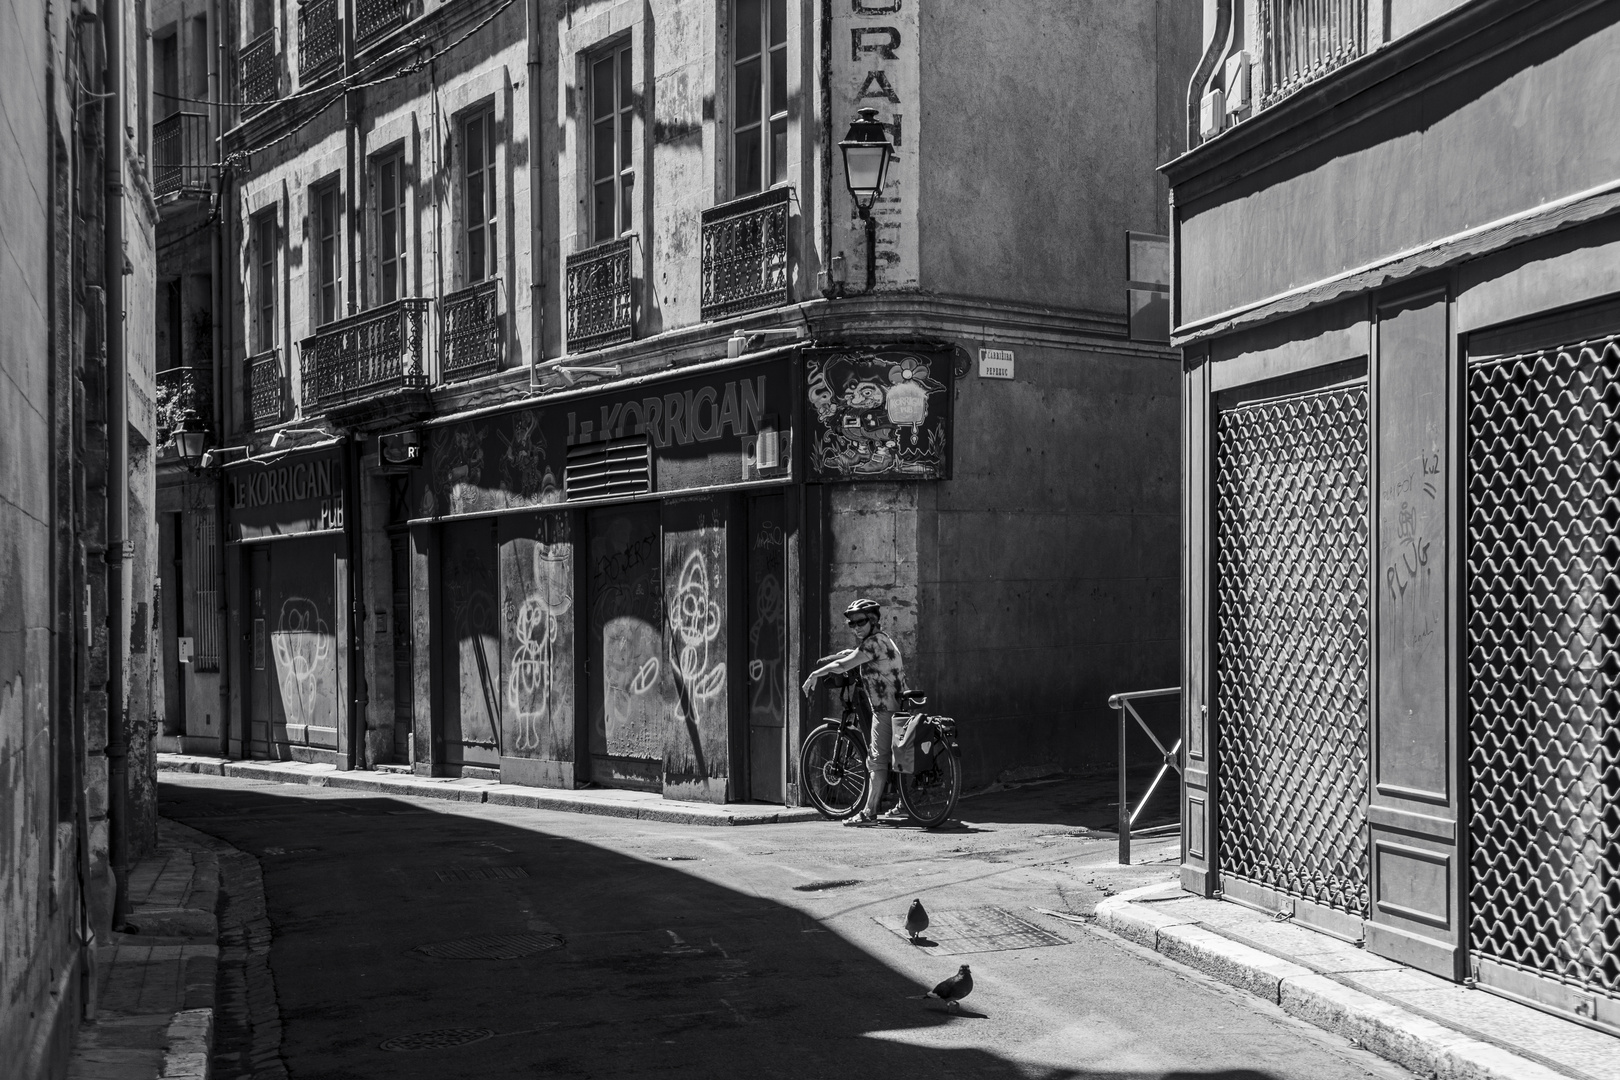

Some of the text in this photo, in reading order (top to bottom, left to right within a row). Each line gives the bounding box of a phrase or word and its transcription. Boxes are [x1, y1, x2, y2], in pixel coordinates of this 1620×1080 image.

[599, 375, 766, 448] KORRIGAN
[741, 430, 792, 480] PB
[250, 458, 332, 507] KORRIGAN
[321, 499, 344, 530] PUB
